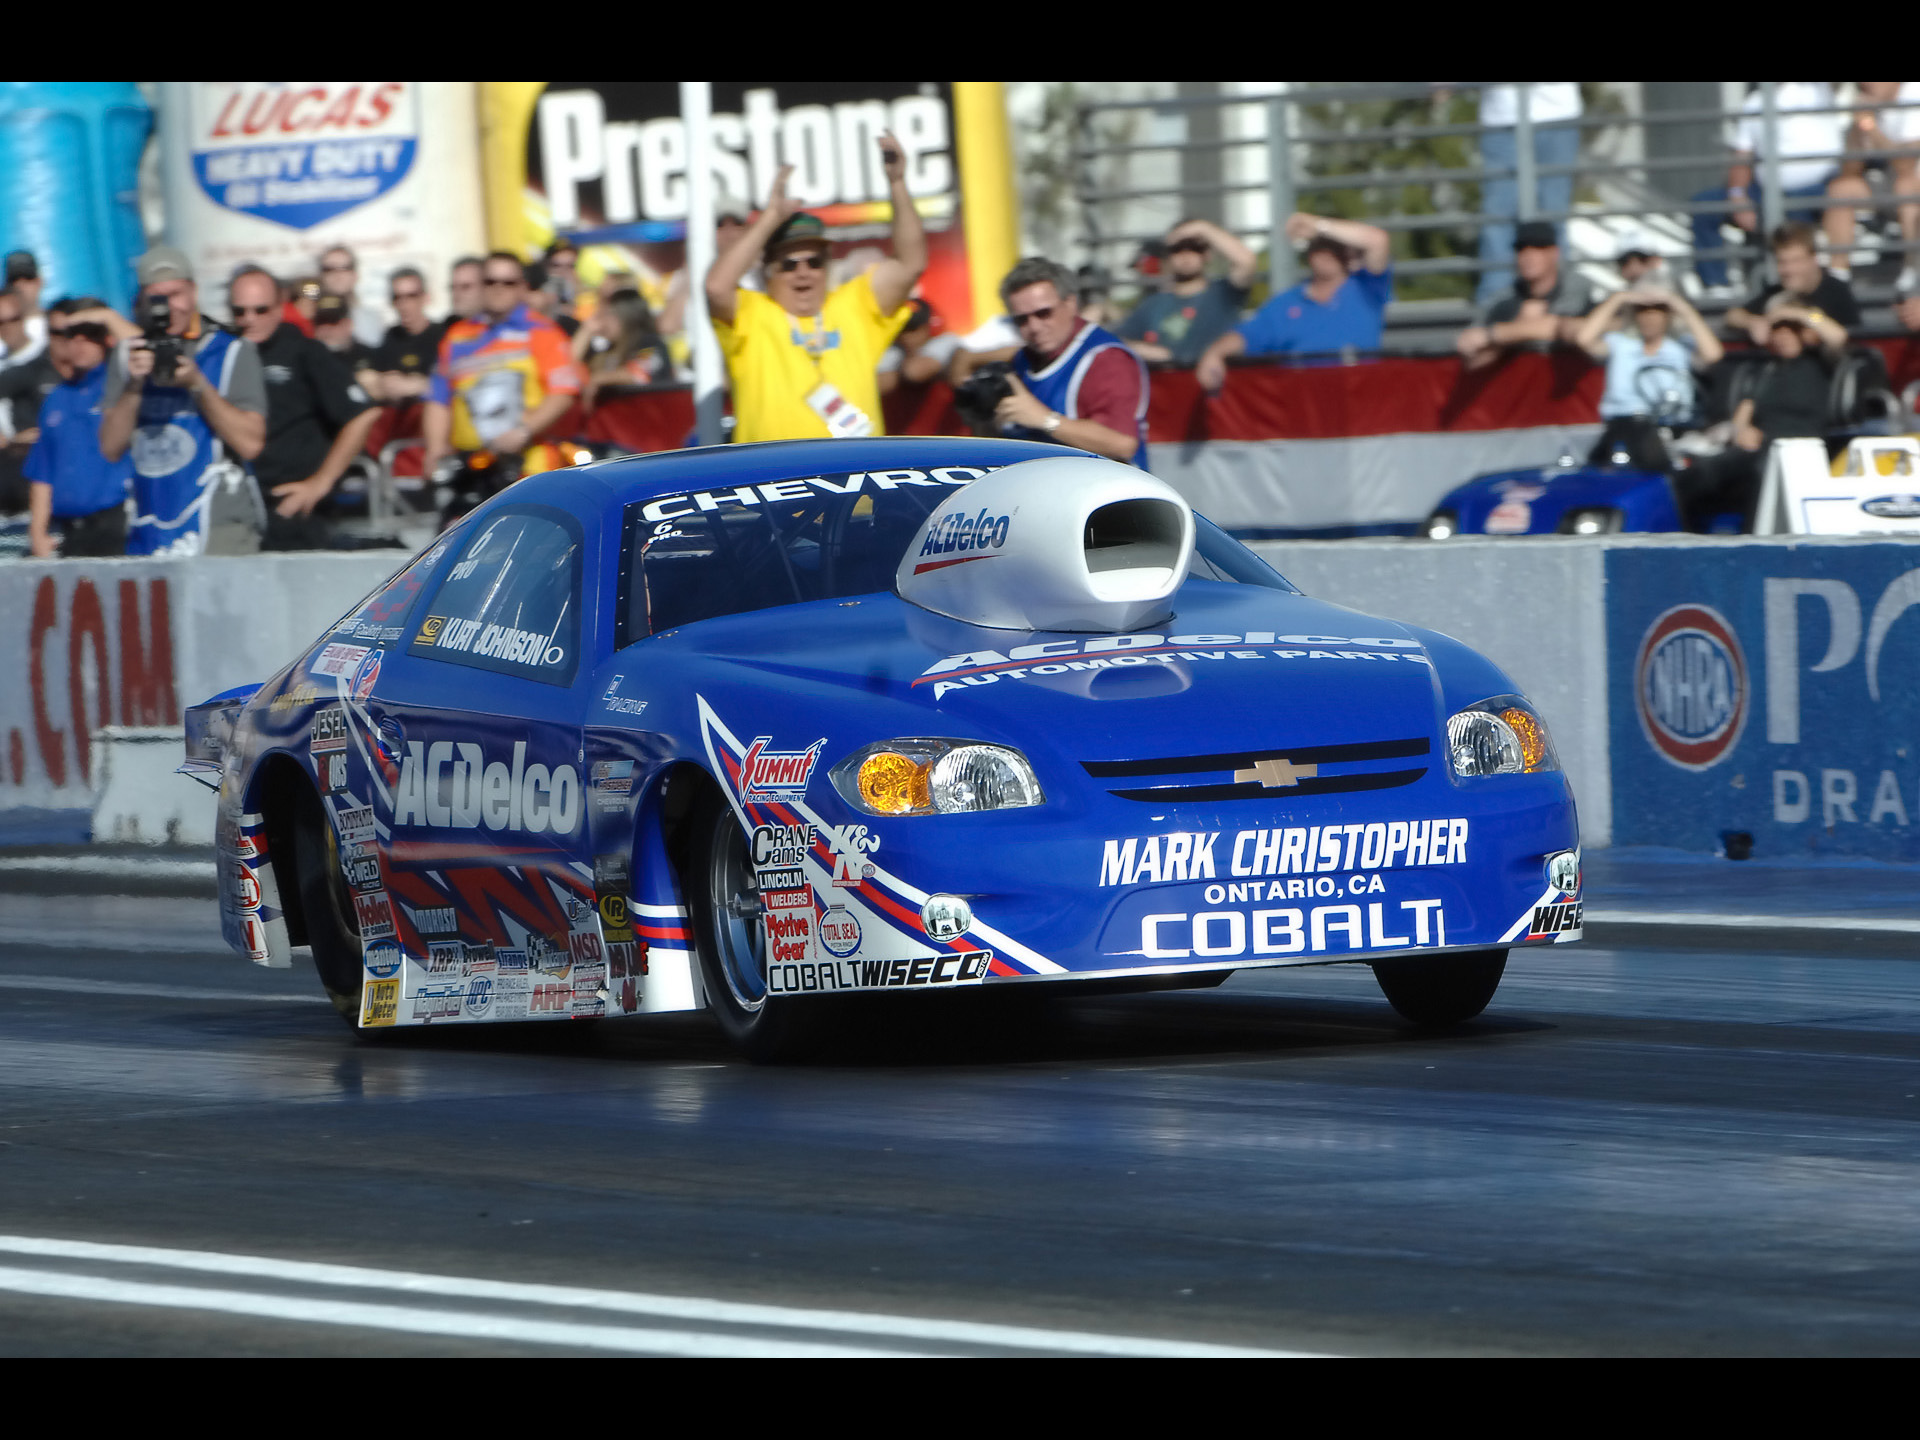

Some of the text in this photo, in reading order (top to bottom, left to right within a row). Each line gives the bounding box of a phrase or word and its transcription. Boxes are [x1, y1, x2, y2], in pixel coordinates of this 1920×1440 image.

[210, 82, 404, 139] LUCAS
[206, 141, 402, 185] HEAVY DUTY
[539, 88, 952, 227] Prestone
[641, 466, 1005, 522] CHEVRO
[647, 530, 682, 544] PRO
[654, 520, 674, 536] 6
[919, 506, 1010, 557] ACDelco
[447, 560, 479, 582] PRO
[437, 617, 550, 666] KURT JOHNSON
[920, 631, 1425, 676] ACDelco
[933, 650, 1430, 701] AUTOMOTIVE PARTS
[311, 709, 346, 739] JESEL
[394, 740, 579, 835] ACDelco
[747, 793, 805, 804] RACING EQUIPMENT
[1772, 769, 1920, 828] DRA
[1099, 818, 1469, 887] MARK CHRISTOPHER
[759, 871, 802, 889] LINCOLN
[1204, 873, 1386, 904] ONTARIO, CA
[770, 891, 808, 907] WELDERS
[765, 913, 808, 938] Motive
[823, 923, 859, 941] TOTAL SEAL
[1141, 898, 1443, 958] COBALT
[570, 932, 602, 964] MSD
[772, 938, 806, 961] Gear
[769, 952, 991, 992] COBALT WISECO PISTON
[465, 980, 492, 1005] HPC
[529, 984, 571, 1011] ARP
